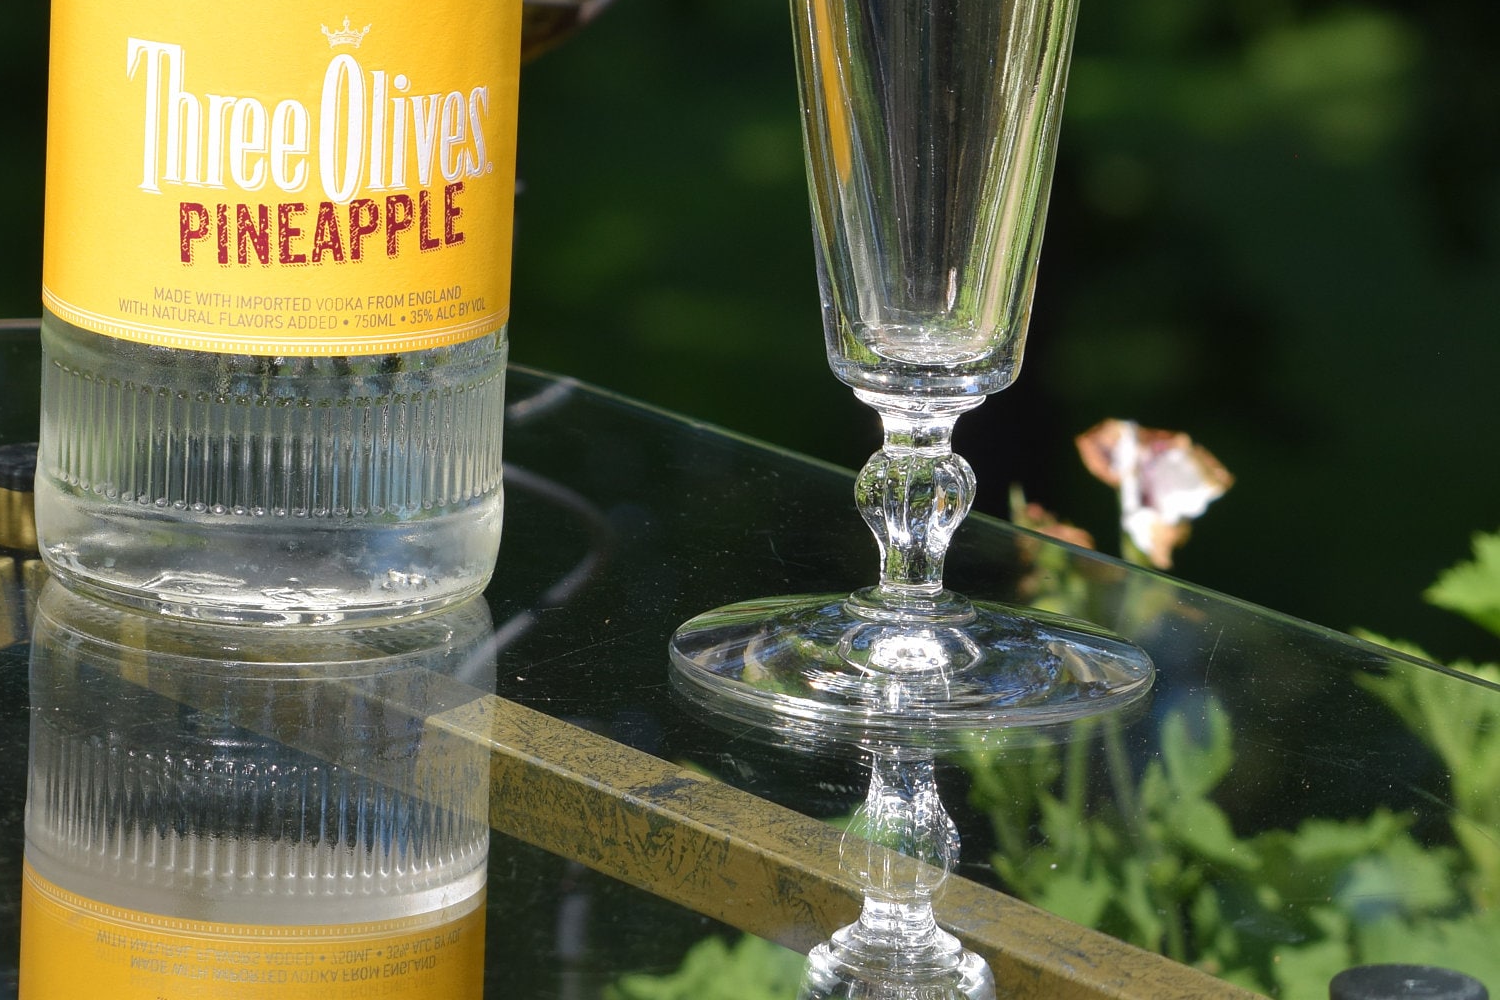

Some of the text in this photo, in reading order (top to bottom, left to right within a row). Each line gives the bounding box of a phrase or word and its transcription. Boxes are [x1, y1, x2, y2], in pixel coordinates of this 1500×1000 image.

[126, 36, 311, 195] Three
[179, 182, 466, 268] PINEAPPLE
[118, 297, 486, 330] WITH NATURAL FLAVORS ADDED 750ML 35% ALC BY VOL
[153, 285, 462, 312] MADE WITH IMPORTED VODKA FROM ENGLAND
